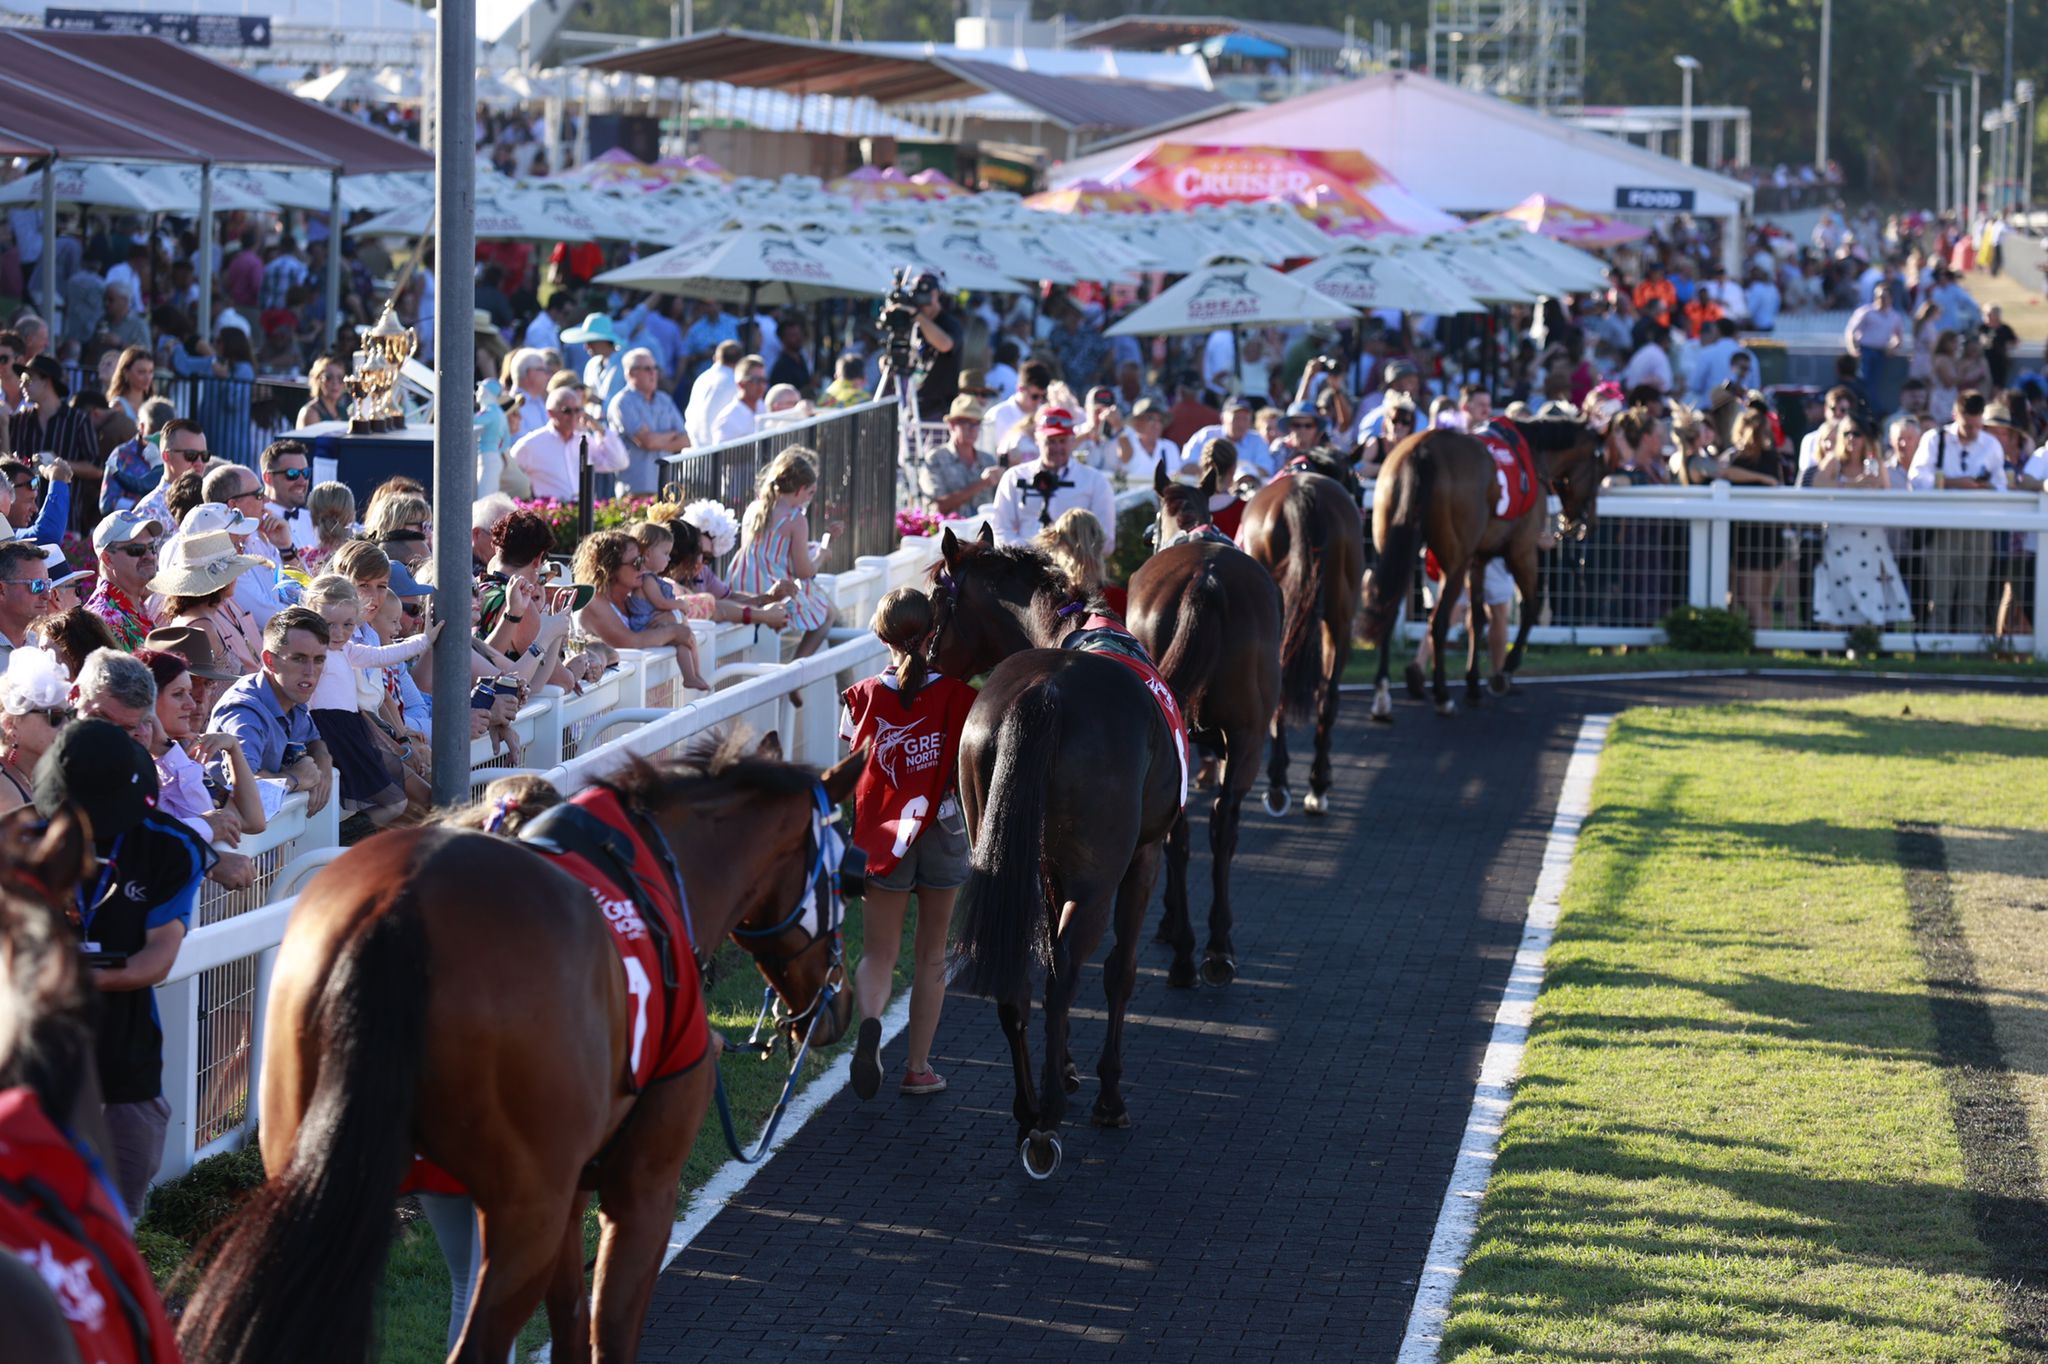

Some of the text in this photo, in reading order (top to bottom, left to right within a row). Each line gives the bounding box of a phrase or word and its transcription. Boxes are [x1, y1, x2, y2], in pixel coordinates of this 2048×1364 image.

[1627, 190, 1682, 208] FOOD
[1187, 298, 1259, 312] GREAT
[904, 732, 944, 755] GRE
[906, 748, 941, 767] NORTH
[891, 795, 929, 858] 6
